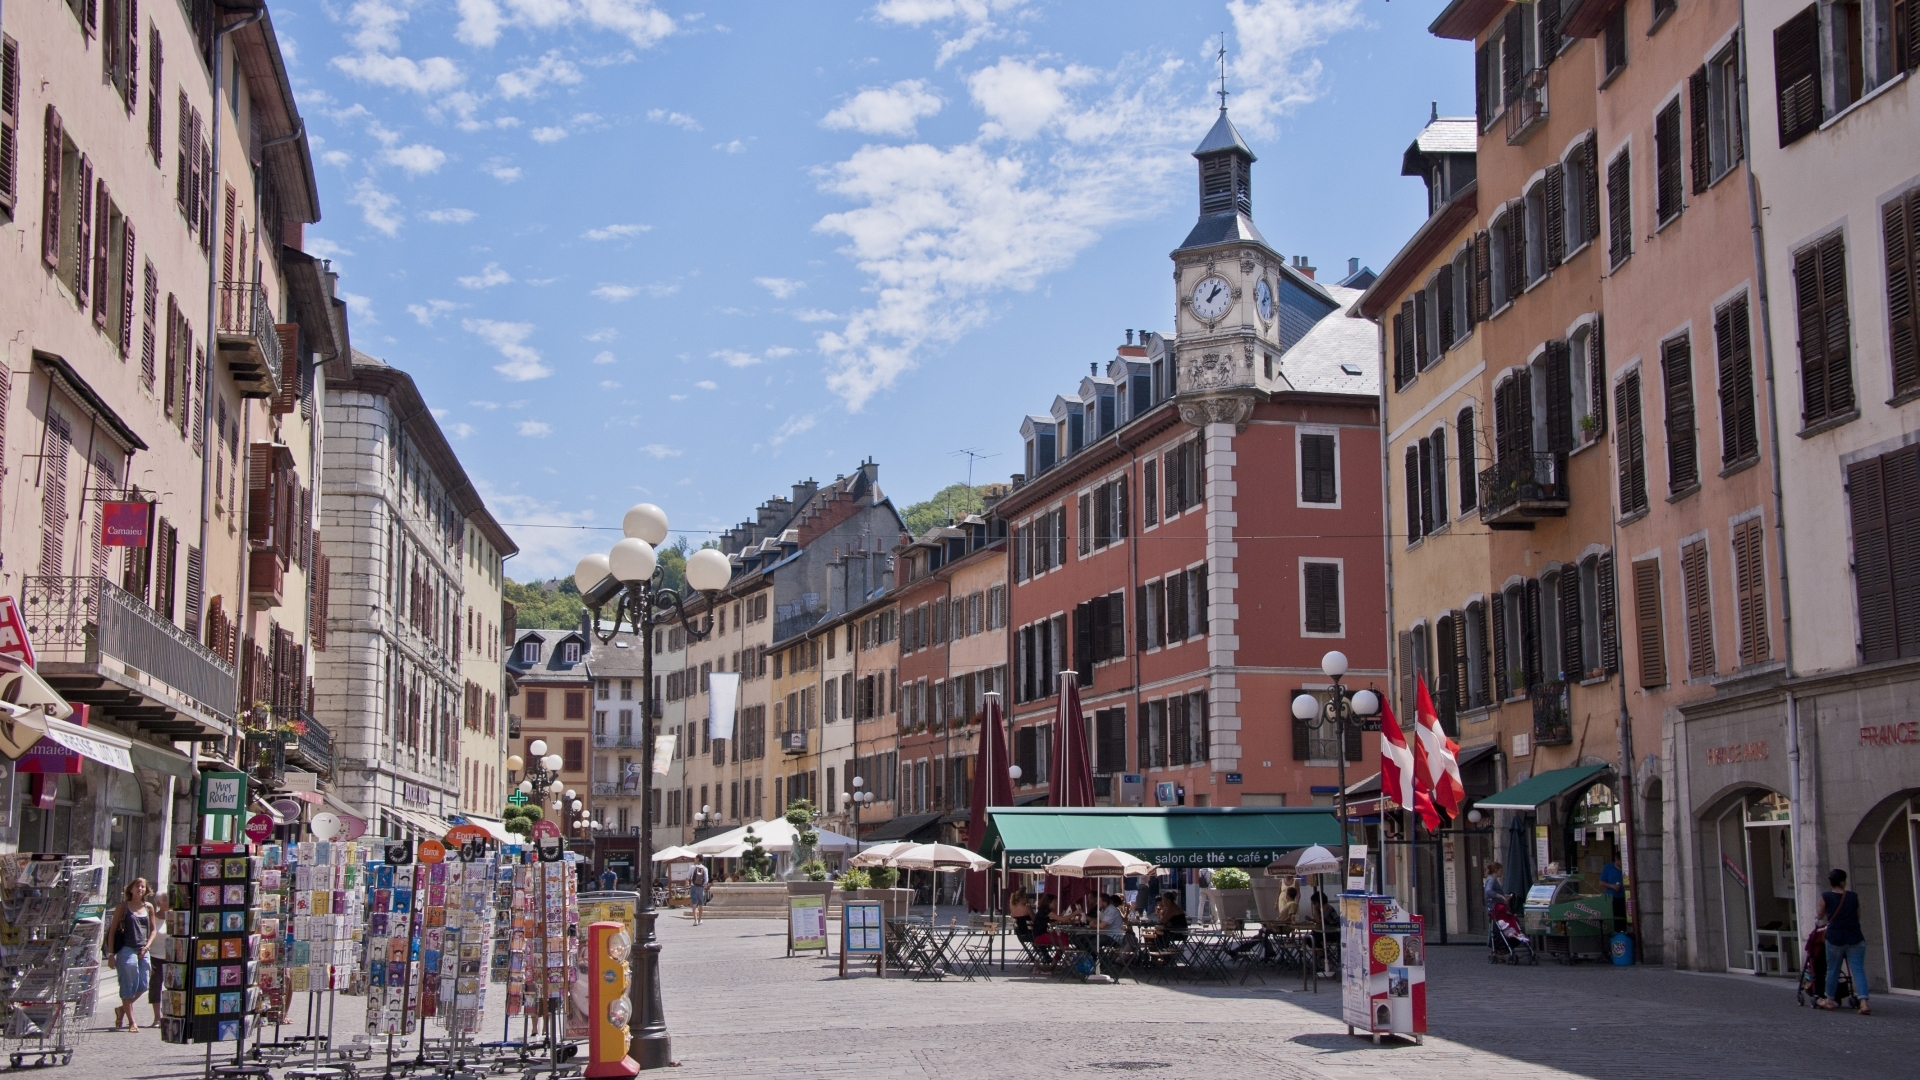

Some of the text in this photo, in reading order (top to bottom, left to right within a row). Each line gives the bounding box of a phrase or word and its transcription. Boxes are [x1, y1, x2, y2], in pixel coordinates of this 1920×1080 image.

[1859, 722, 1919, 747] FRANCE
[215, 782, 231, 794] Yves
[209, 791, 237, 803] Rocher
[1009, 852, 1065, 864] resto'ra
[1155, 852, 1185, 863] salon
[1189, 852, 1203, 863] de
[1207, 851, 1225, 863] thé
[1236, 851, 1261, 863] café
